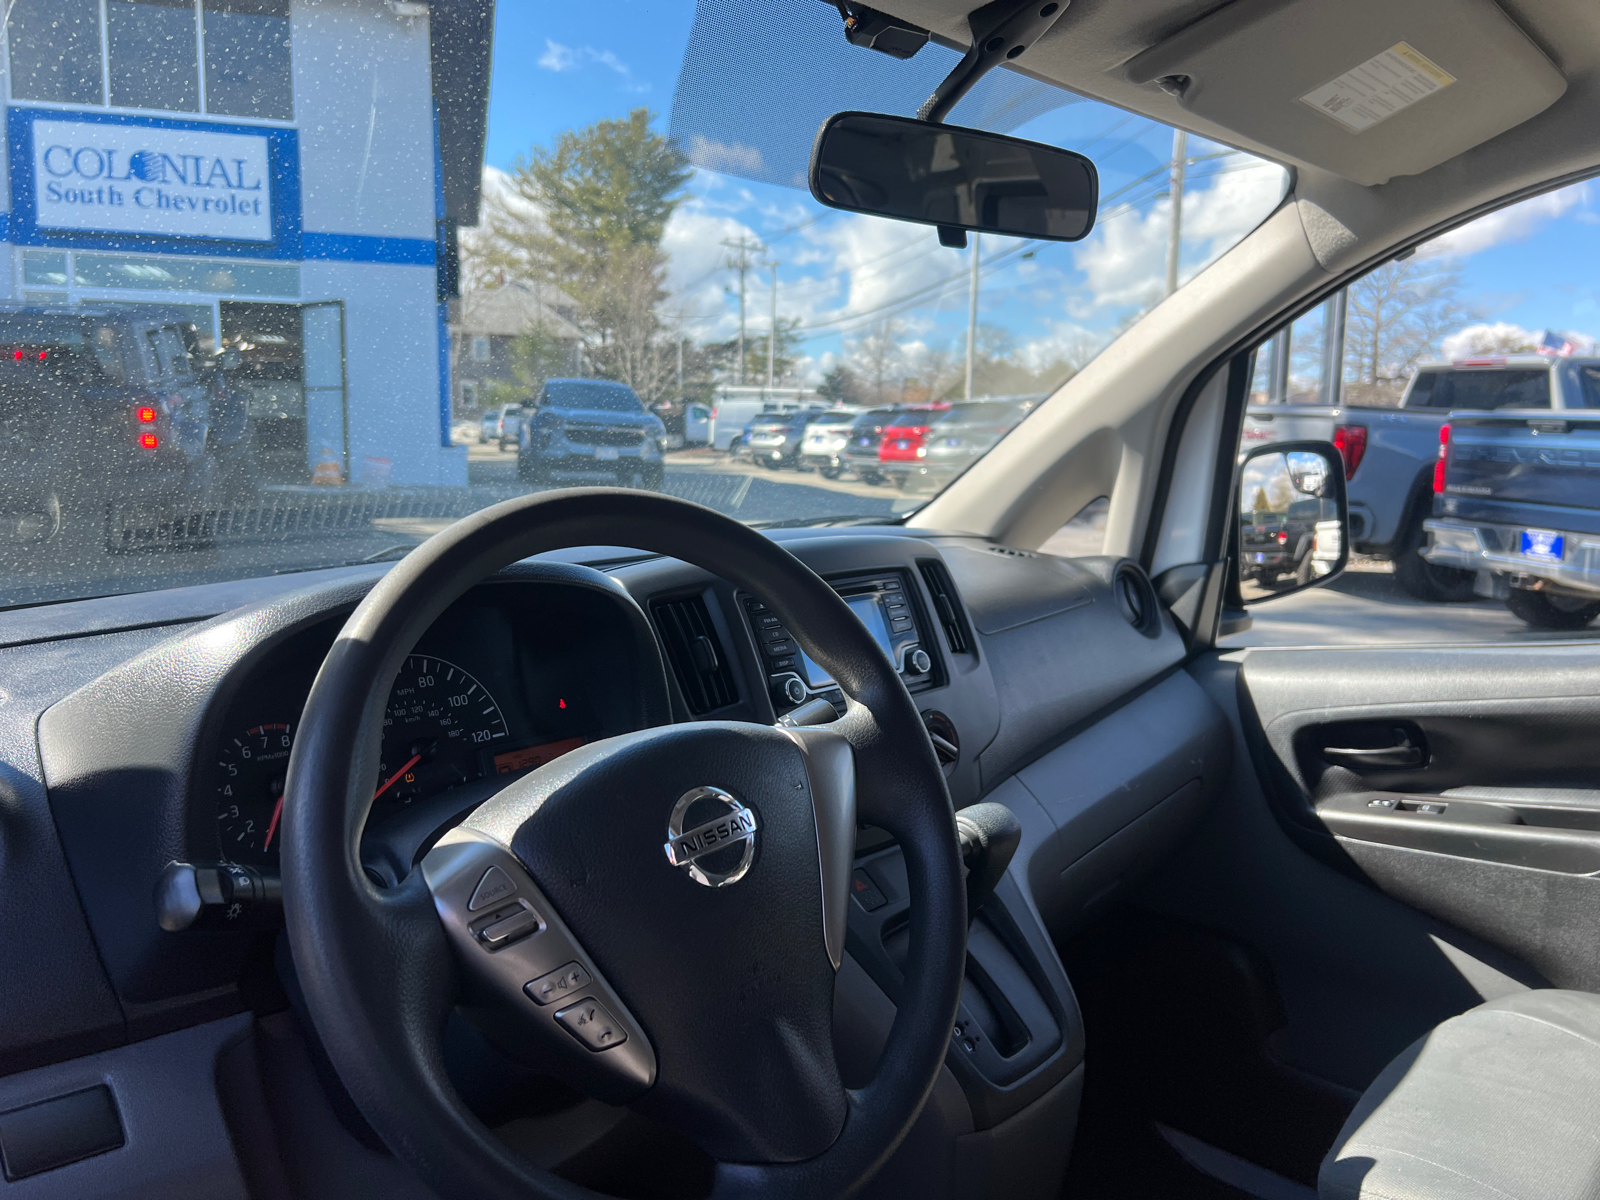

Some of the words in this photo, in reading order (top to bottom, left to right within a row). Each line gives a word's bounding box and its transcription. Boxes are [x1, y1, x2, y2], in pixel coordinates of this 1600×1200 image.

[46, 180, 124, 206] South
[135, 186, 262, 217] Chevrolet
[418, 675, 435, 688] 80
[397, 687, 415, 696] MPH
[447, 694, 468, 707] 100
[393, 708, 406, 717] 100
[411, 705, 423, 714] 120
[428, 709, 440, 718] 140
[440, 718, 452, 726] 160
[448, 728, 460, 737] 180
[472, 729, 491, 743] 120
[260, 736, 268, 749] 7
[281, 735, 291, 747] 8
[242, 746, 251, 758] 6
[228, 763, 238, 776] 5
[223, 784, 233, 796] 4
[230, 805, 239, 818] 3
[245, 820, 255, 833] 2
[680, 813, 753, 856] NISSAN
[480, 883, 508, 901] SOURCE
[953, 1026, 961, 1037] D
[963, 1042, 973, 1052] L
